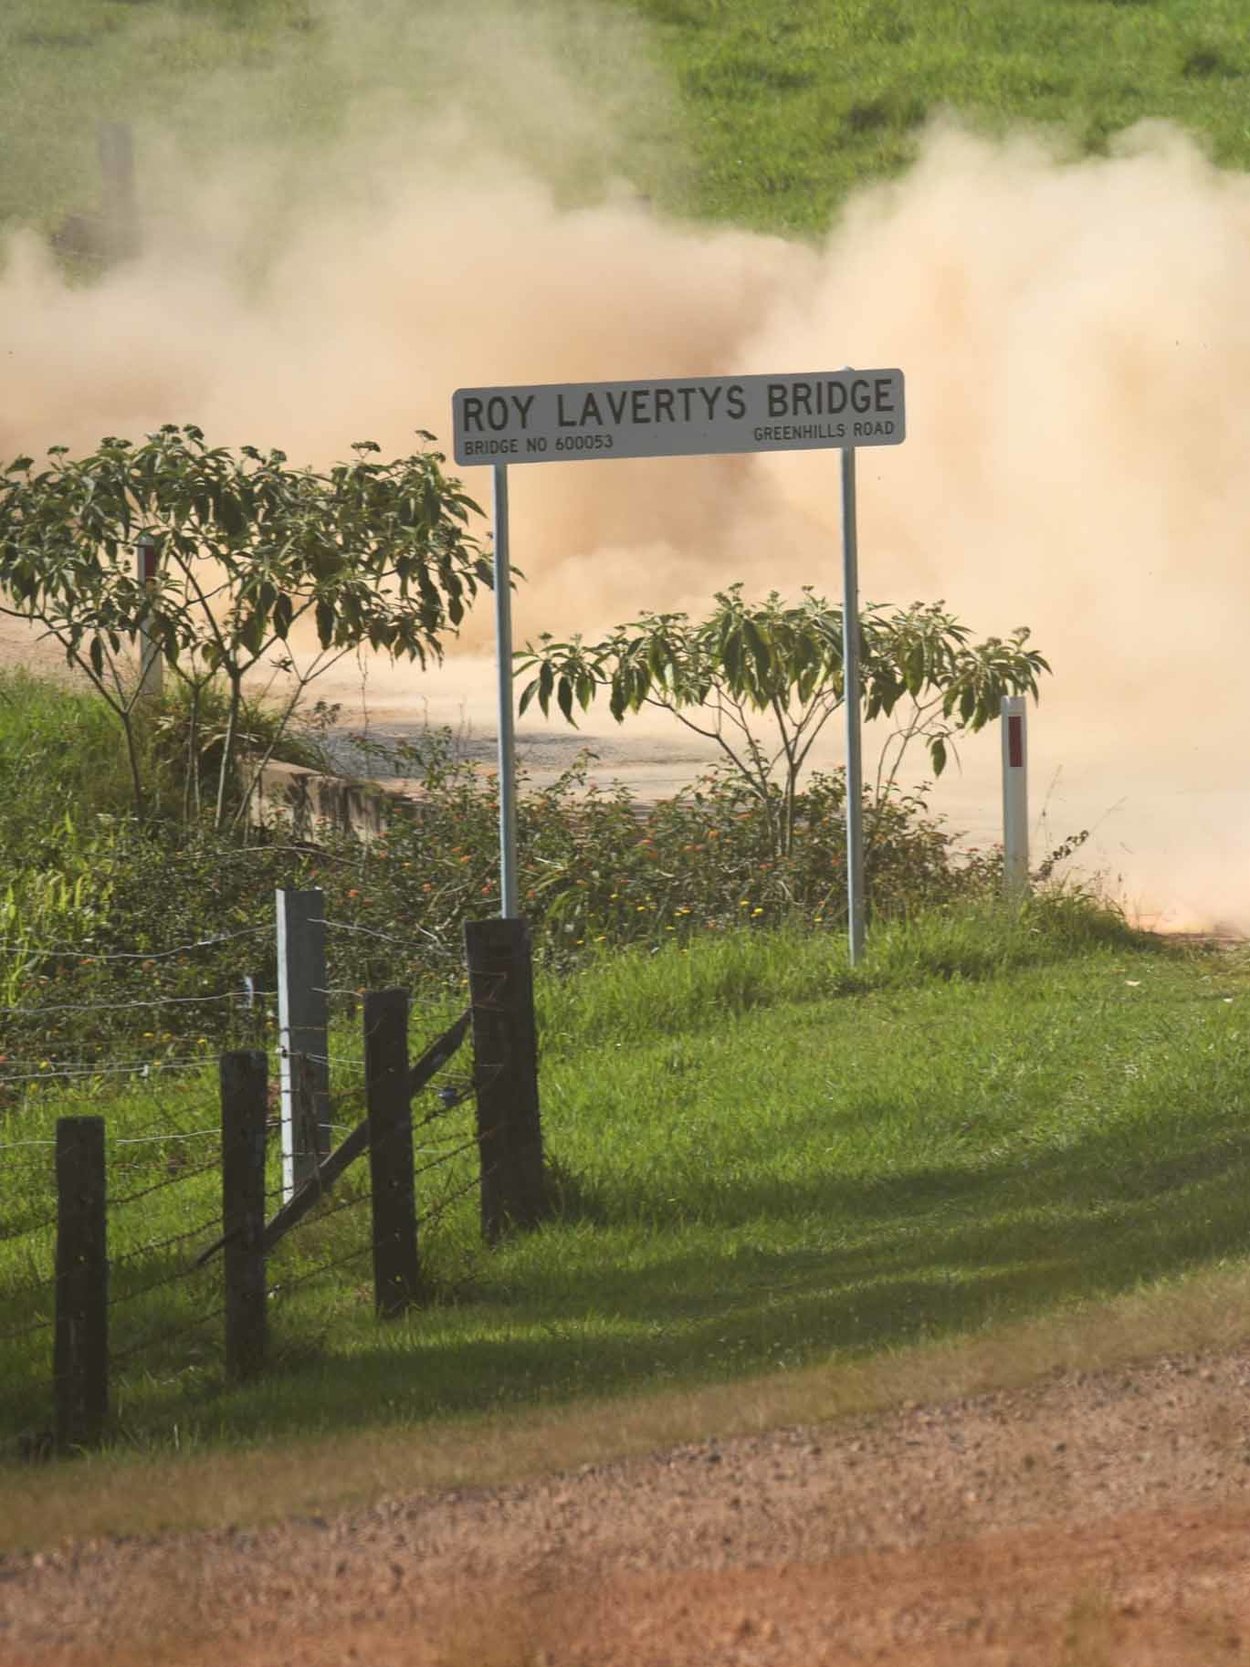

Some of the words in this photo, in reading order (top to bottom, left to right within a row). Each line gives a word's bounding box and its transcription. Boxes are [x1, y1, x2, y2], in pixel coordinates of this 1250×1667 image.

[463, 394, 534, 432] ROY
[558, 384, 747, 427] LAVERTYS
[767, 378, 895, 419] BRIDGE
[754, 422, 845, 442] GREENHILLS
[854, 420, 894, 438] ROAD
[464, 438, 519, 456] BRIDGE
[526, 437, 548, 453] NO
[555, 434, 613, 452] 600053
